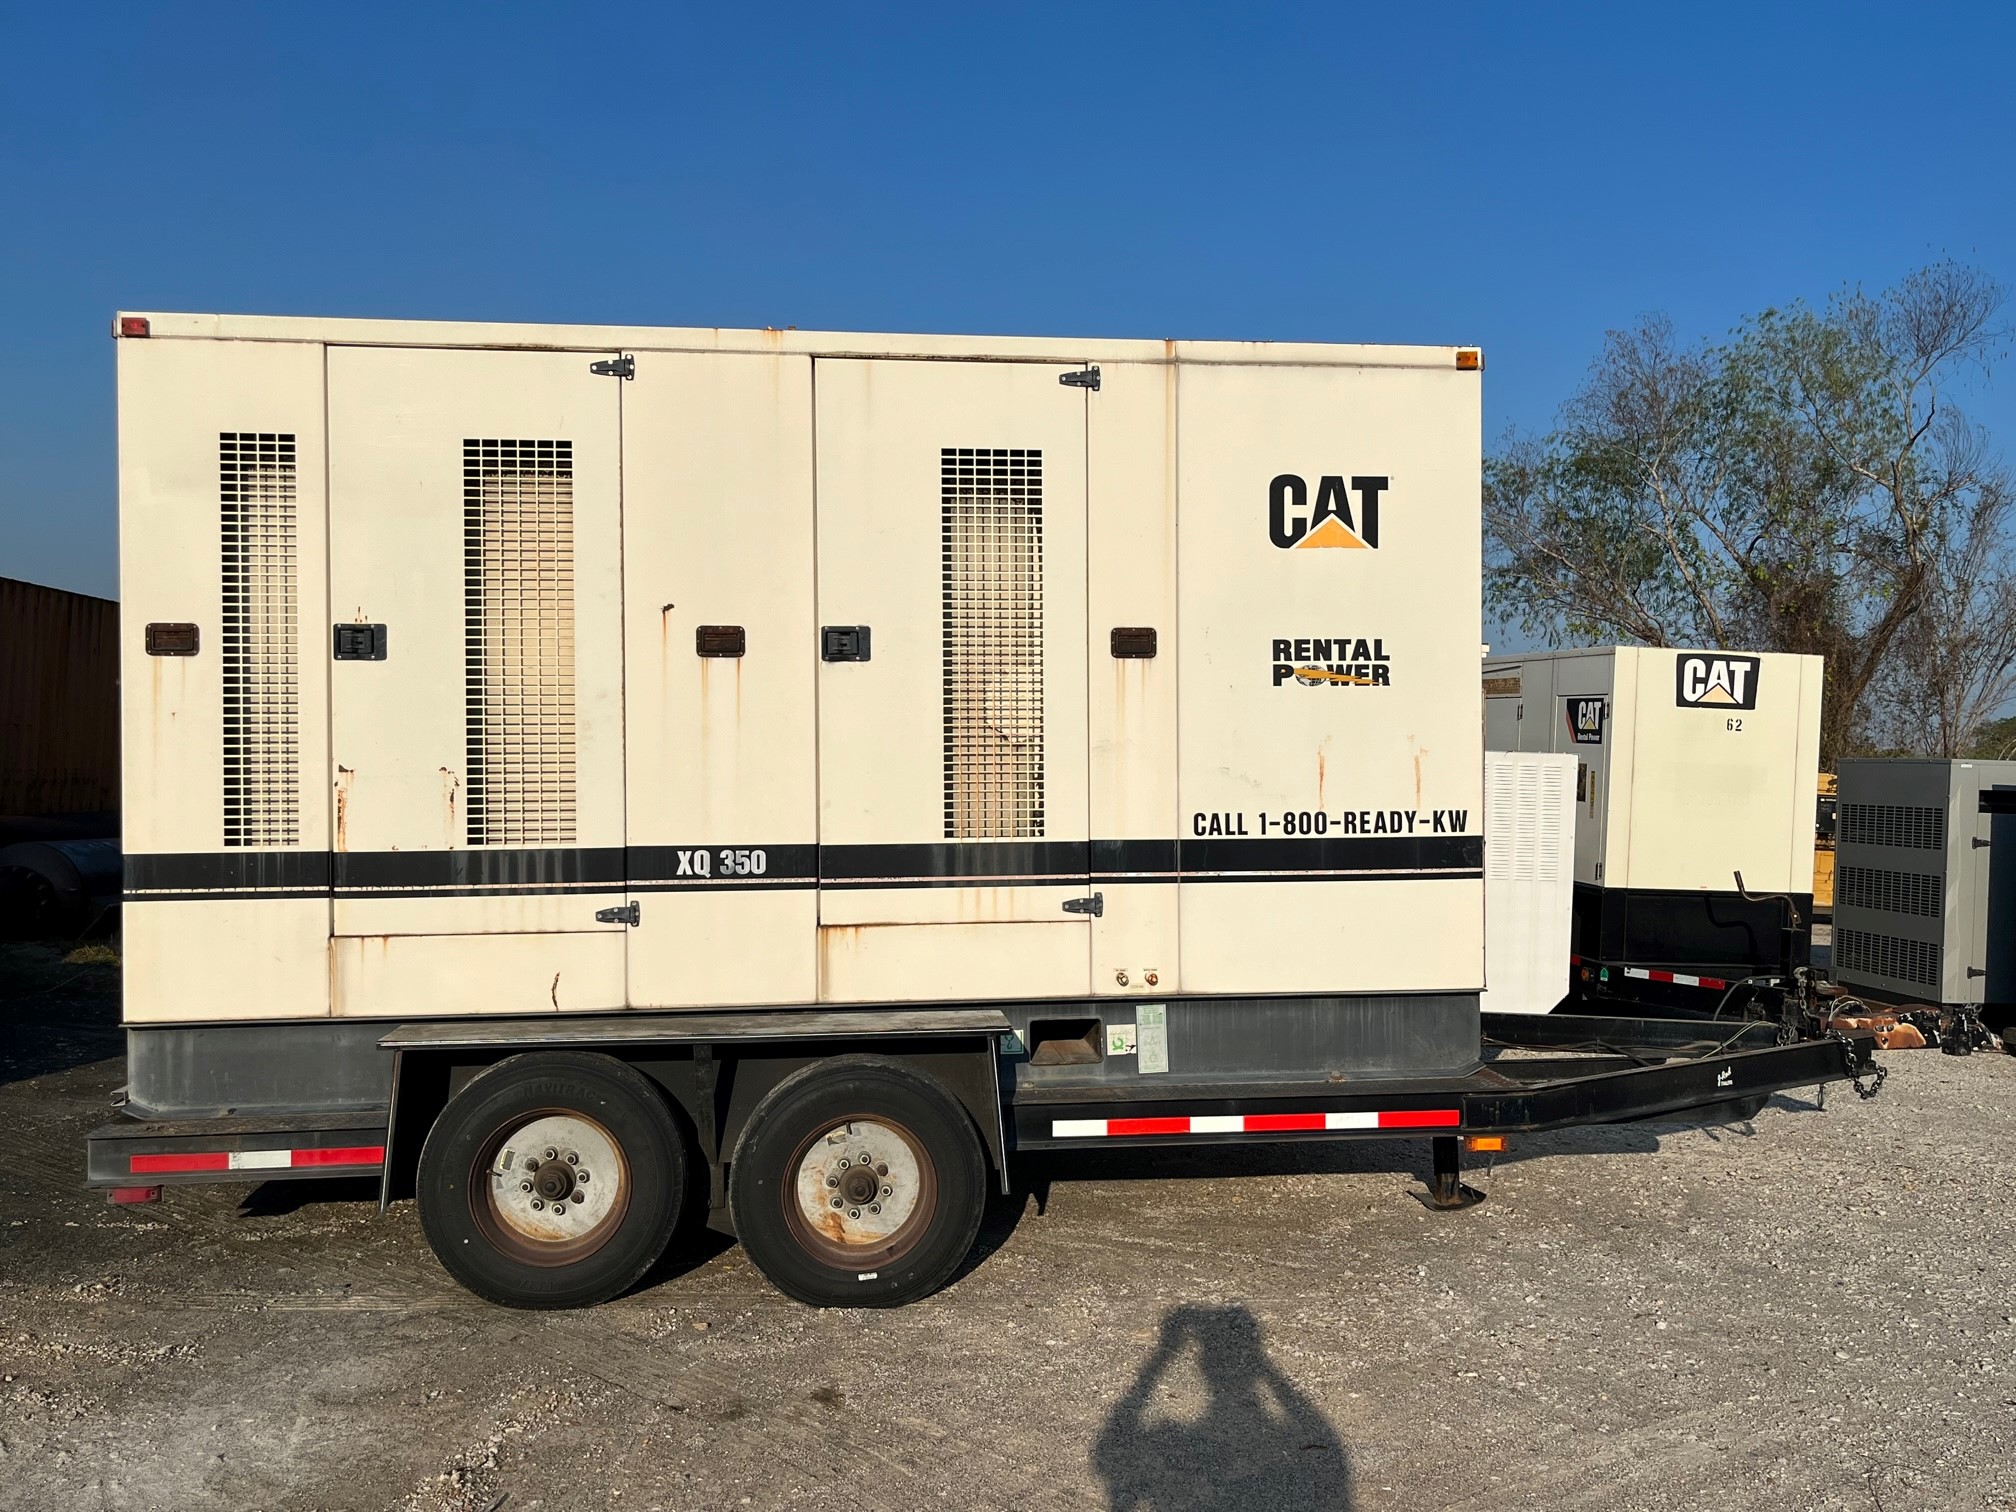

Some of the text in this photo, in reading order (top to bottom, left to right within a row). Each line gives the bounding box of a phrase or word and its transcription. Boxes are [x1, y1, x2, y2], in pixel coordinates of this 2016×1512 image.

[1269, 474, 1388, 549] CAT
[1272, 639, 1390, 661] RENTAL
[1272, 664, 1390, 686] POWER
[1683, 658, 1750, 704] CAT
[1578, 701, 1601, 729] CAT
[1726, 718, 1743, 732] 62
[1193, 810, 1468, 836] CALL 1-800-READY-KW
[676, 849, 767, 878] XQ 350
